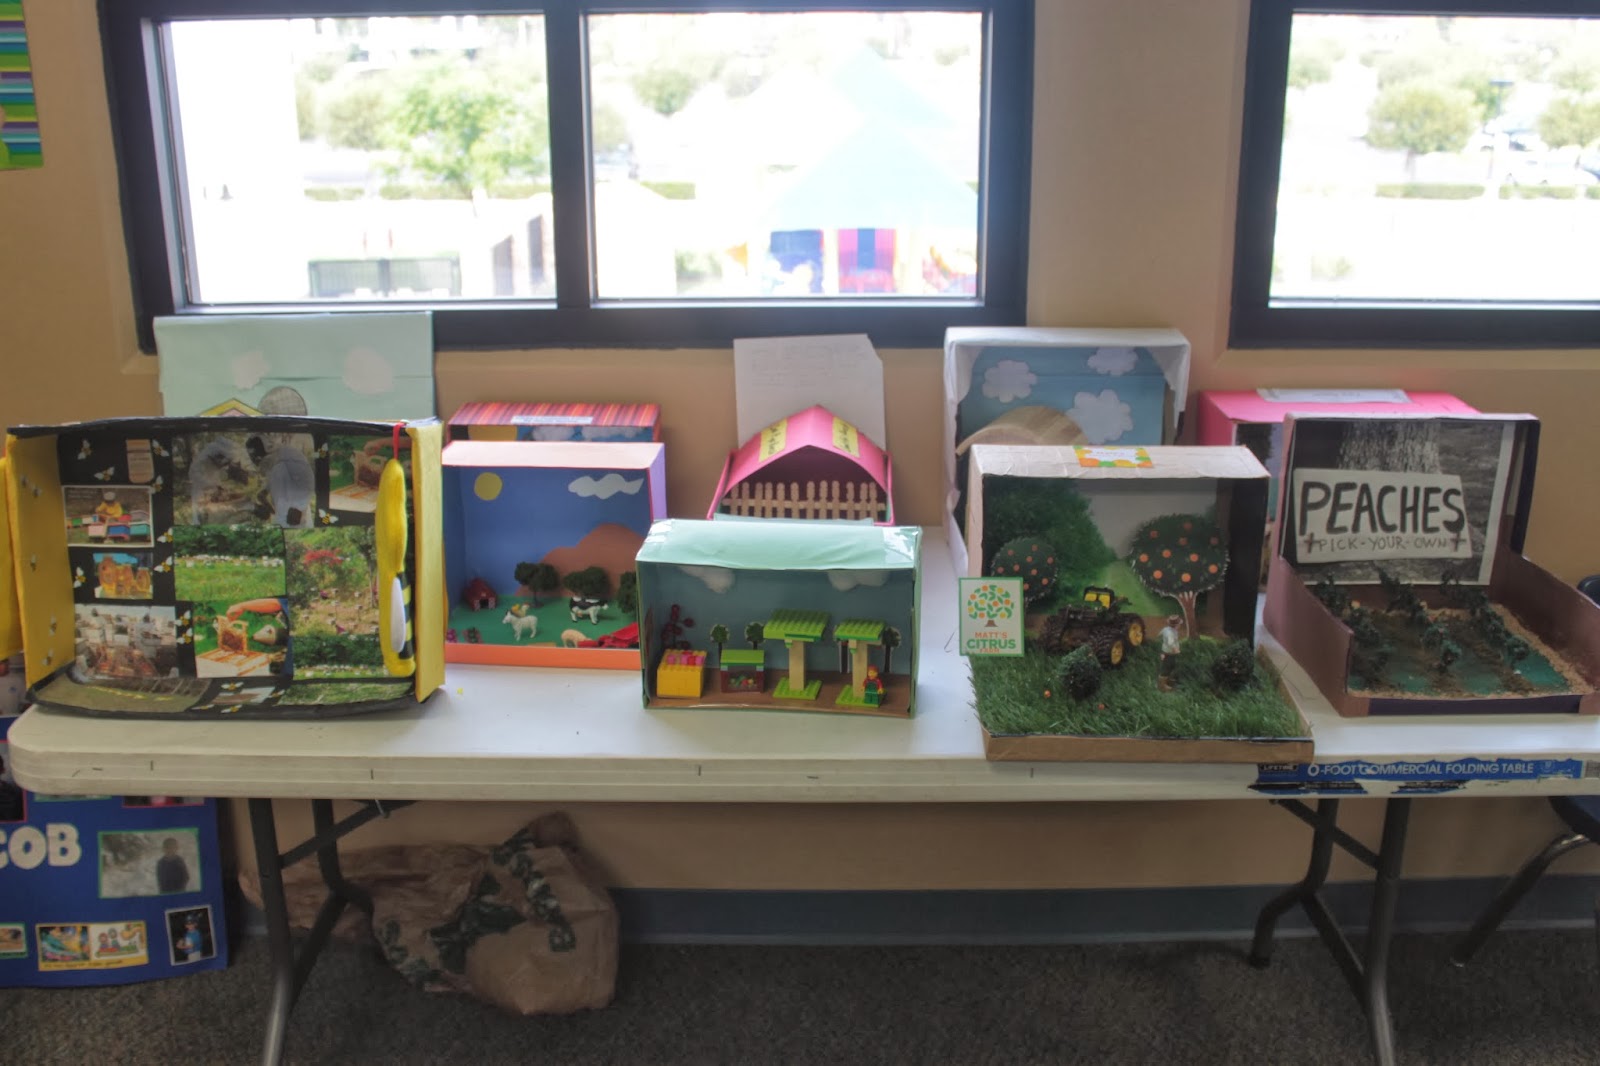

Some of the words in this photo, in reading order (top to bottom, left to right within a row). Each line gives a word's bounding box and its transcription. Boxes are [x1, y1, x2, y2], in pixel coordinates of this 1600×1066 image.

[1299, 481, 1465, 536] PEACHES
[966, 639, 1017, 649] CITRUS
[1445, 762, 1499, 774] FOLDING
[1501, 762, 1534, 774] TABLE
[0, 823, 82, 869] OB
